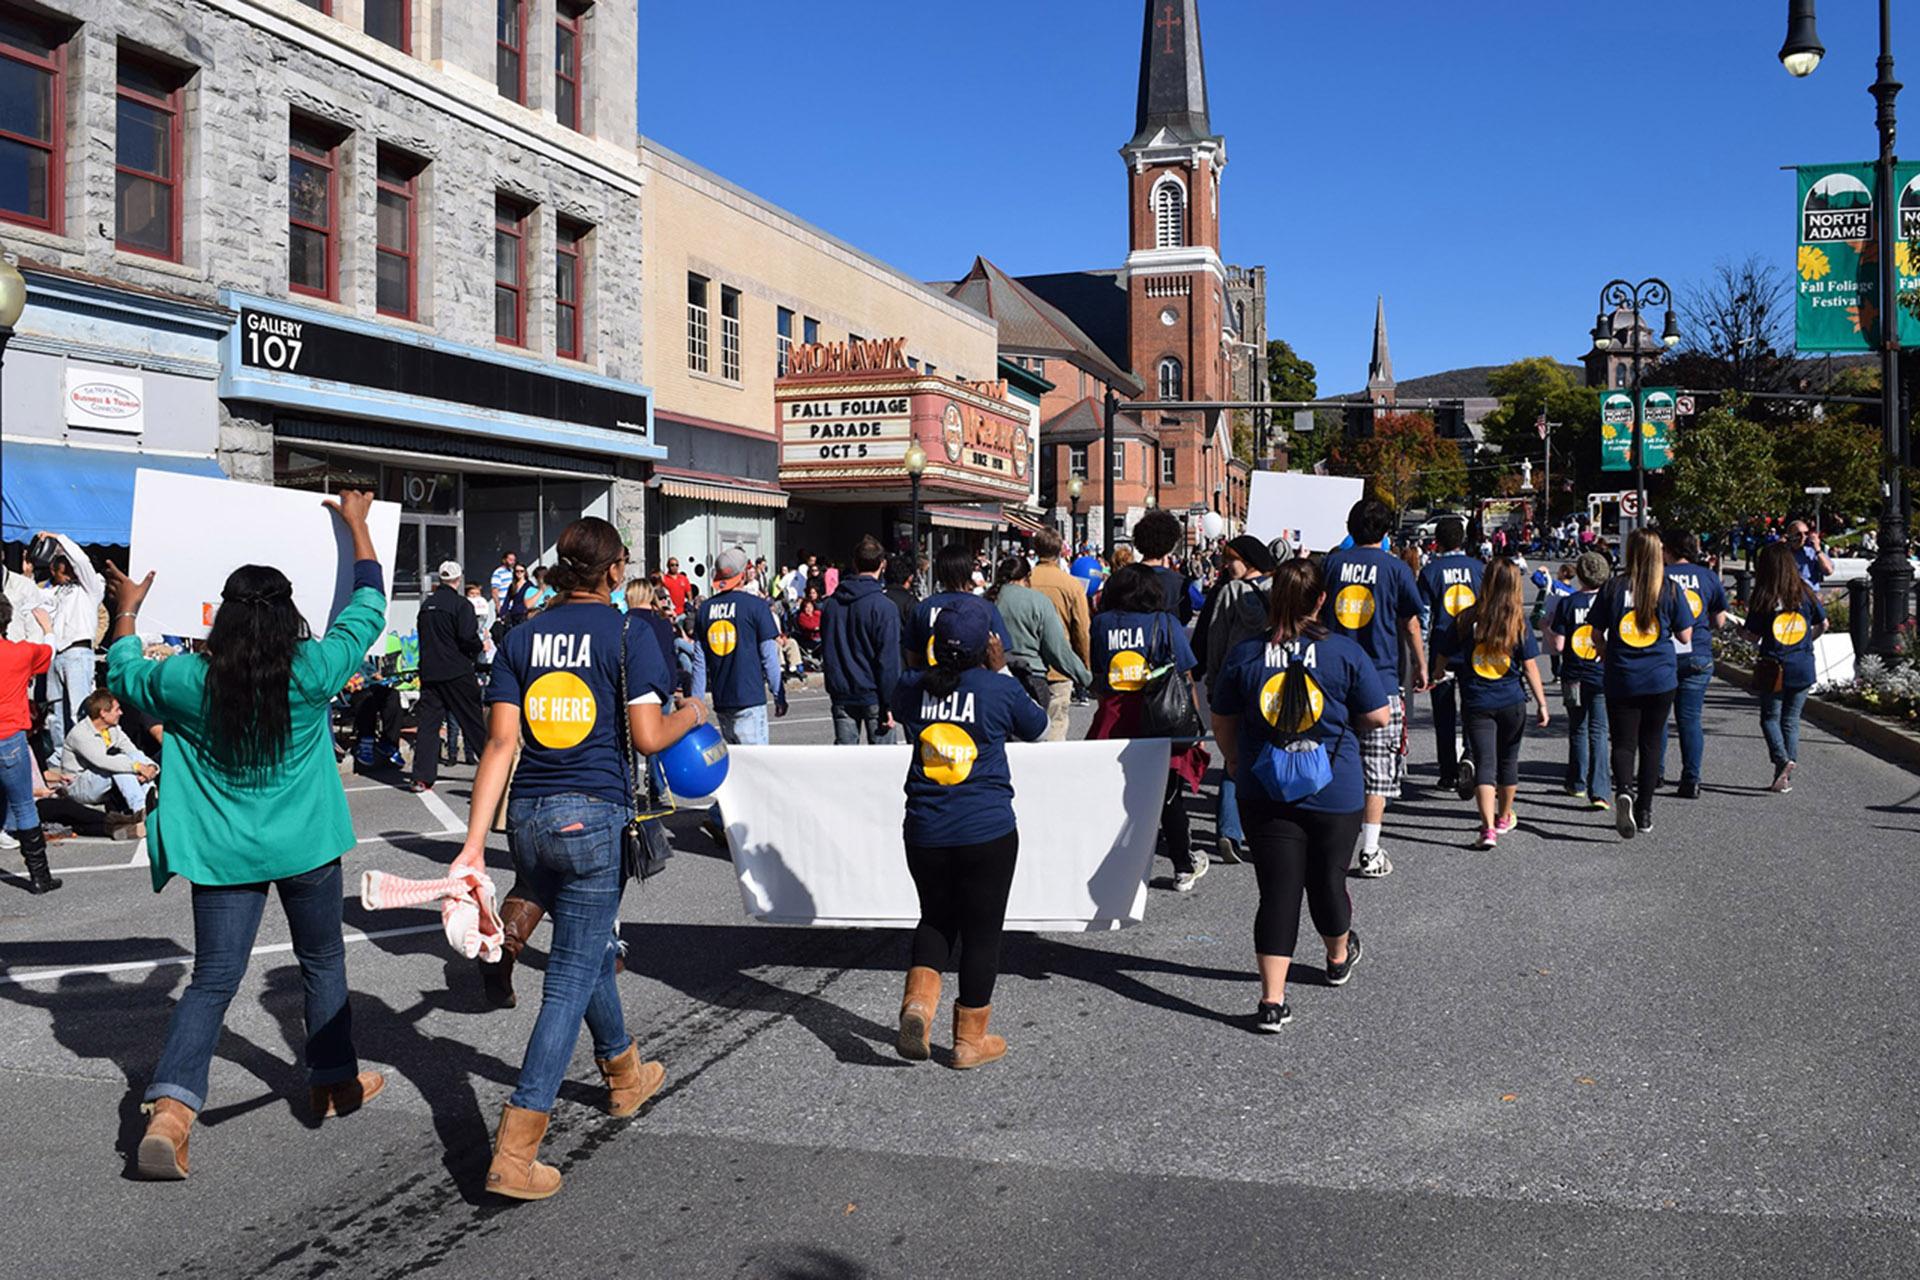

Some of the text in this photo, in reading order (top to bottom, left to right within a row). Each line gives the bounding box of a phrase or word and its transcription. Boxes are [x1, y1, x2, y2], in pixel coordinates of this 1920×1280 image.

[1809, 213, 1867, 226] NORTH
[1808, 225, 1867, 239] ADAMS
[1801, 281, 1824, 293] Fall
[1812, 296, 1861, 307] Festival
[247, 313, 302, 339] GALLERY
[248, 331, 302, 371] 107
[788, 336, 909, 374] MOHAWK
[791, 399, 908, 418] FALL FOLIAGE
[810, 422, 881, 438] PARADE
[820, 444, 868, 459] OCT 5
[403, 475, 437, 502] 107
[1341, 563, 1377, 584] MCLA
[1443, 568, 1472, 584] MCLA
[709, 602, 736, 619] MCLA
[1108, 627, 1144, 650] MCLA
[531, 633, 591, 668] MCLA
[529, 696, 591, 721] BE HERE
[921, 690, 975, 723] MCLA
